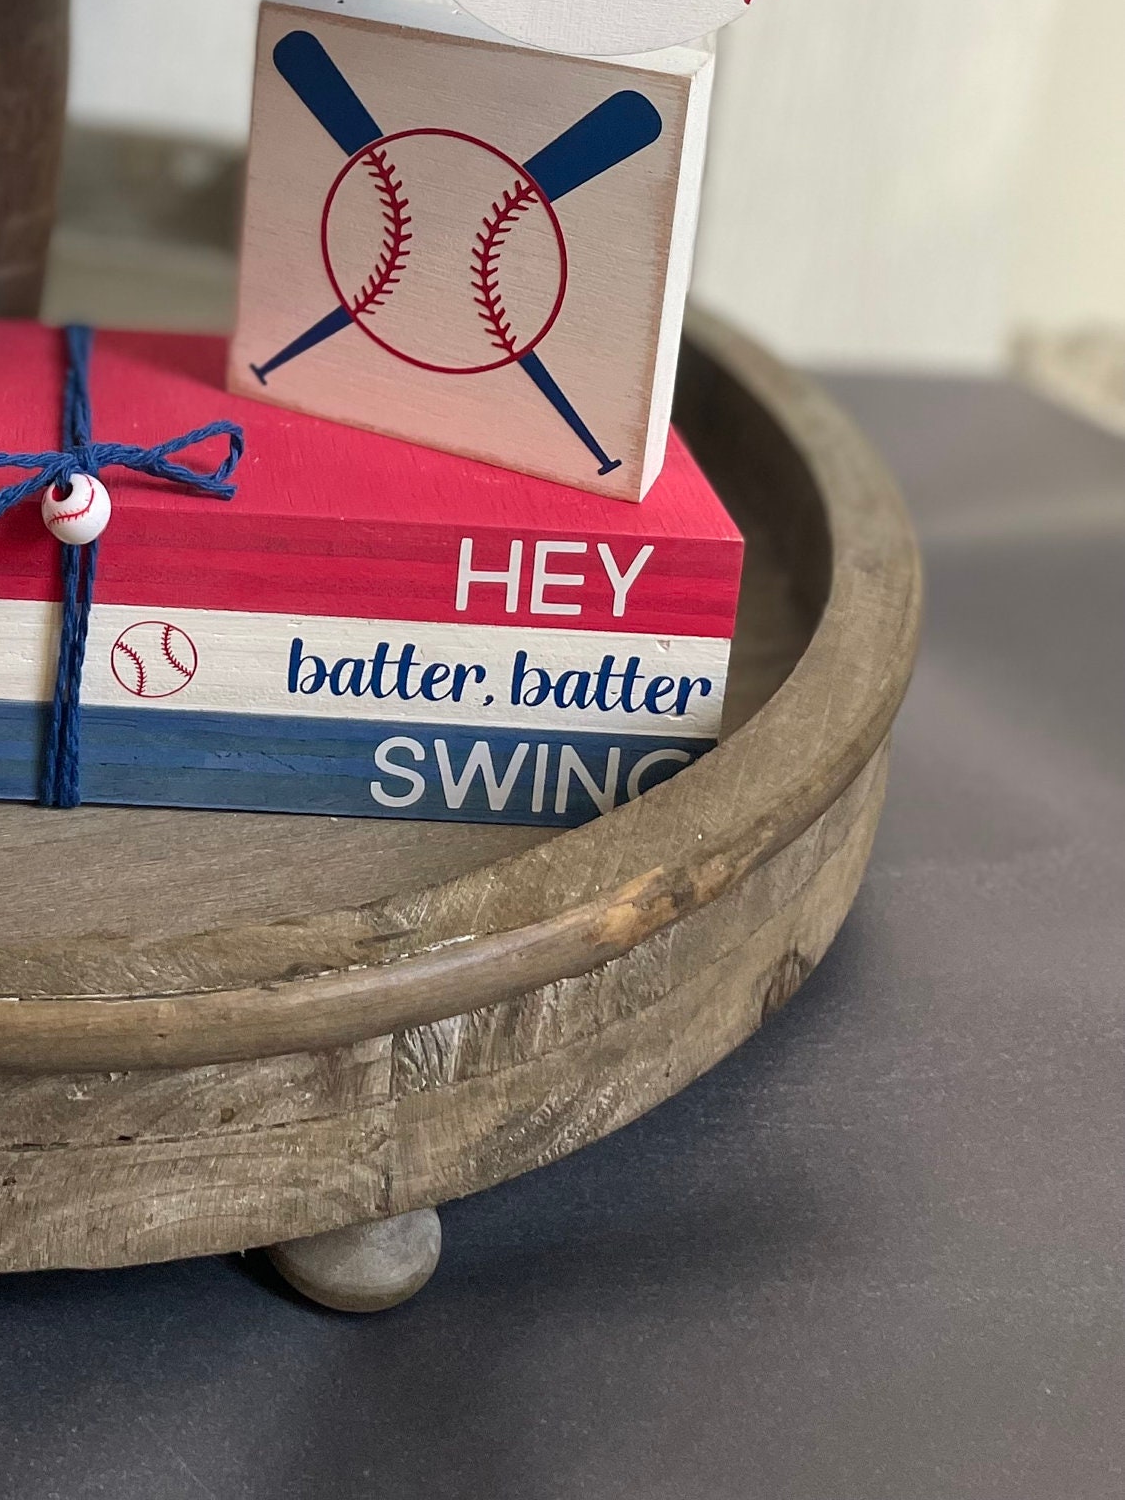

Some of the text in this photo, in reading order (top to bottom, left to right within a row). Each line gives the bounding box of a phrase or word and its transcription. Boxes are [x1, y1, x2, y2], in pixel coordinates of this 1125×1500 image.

[455, 537, 655, 617] HEY
[287, 637, 712, 716] batter, batter
